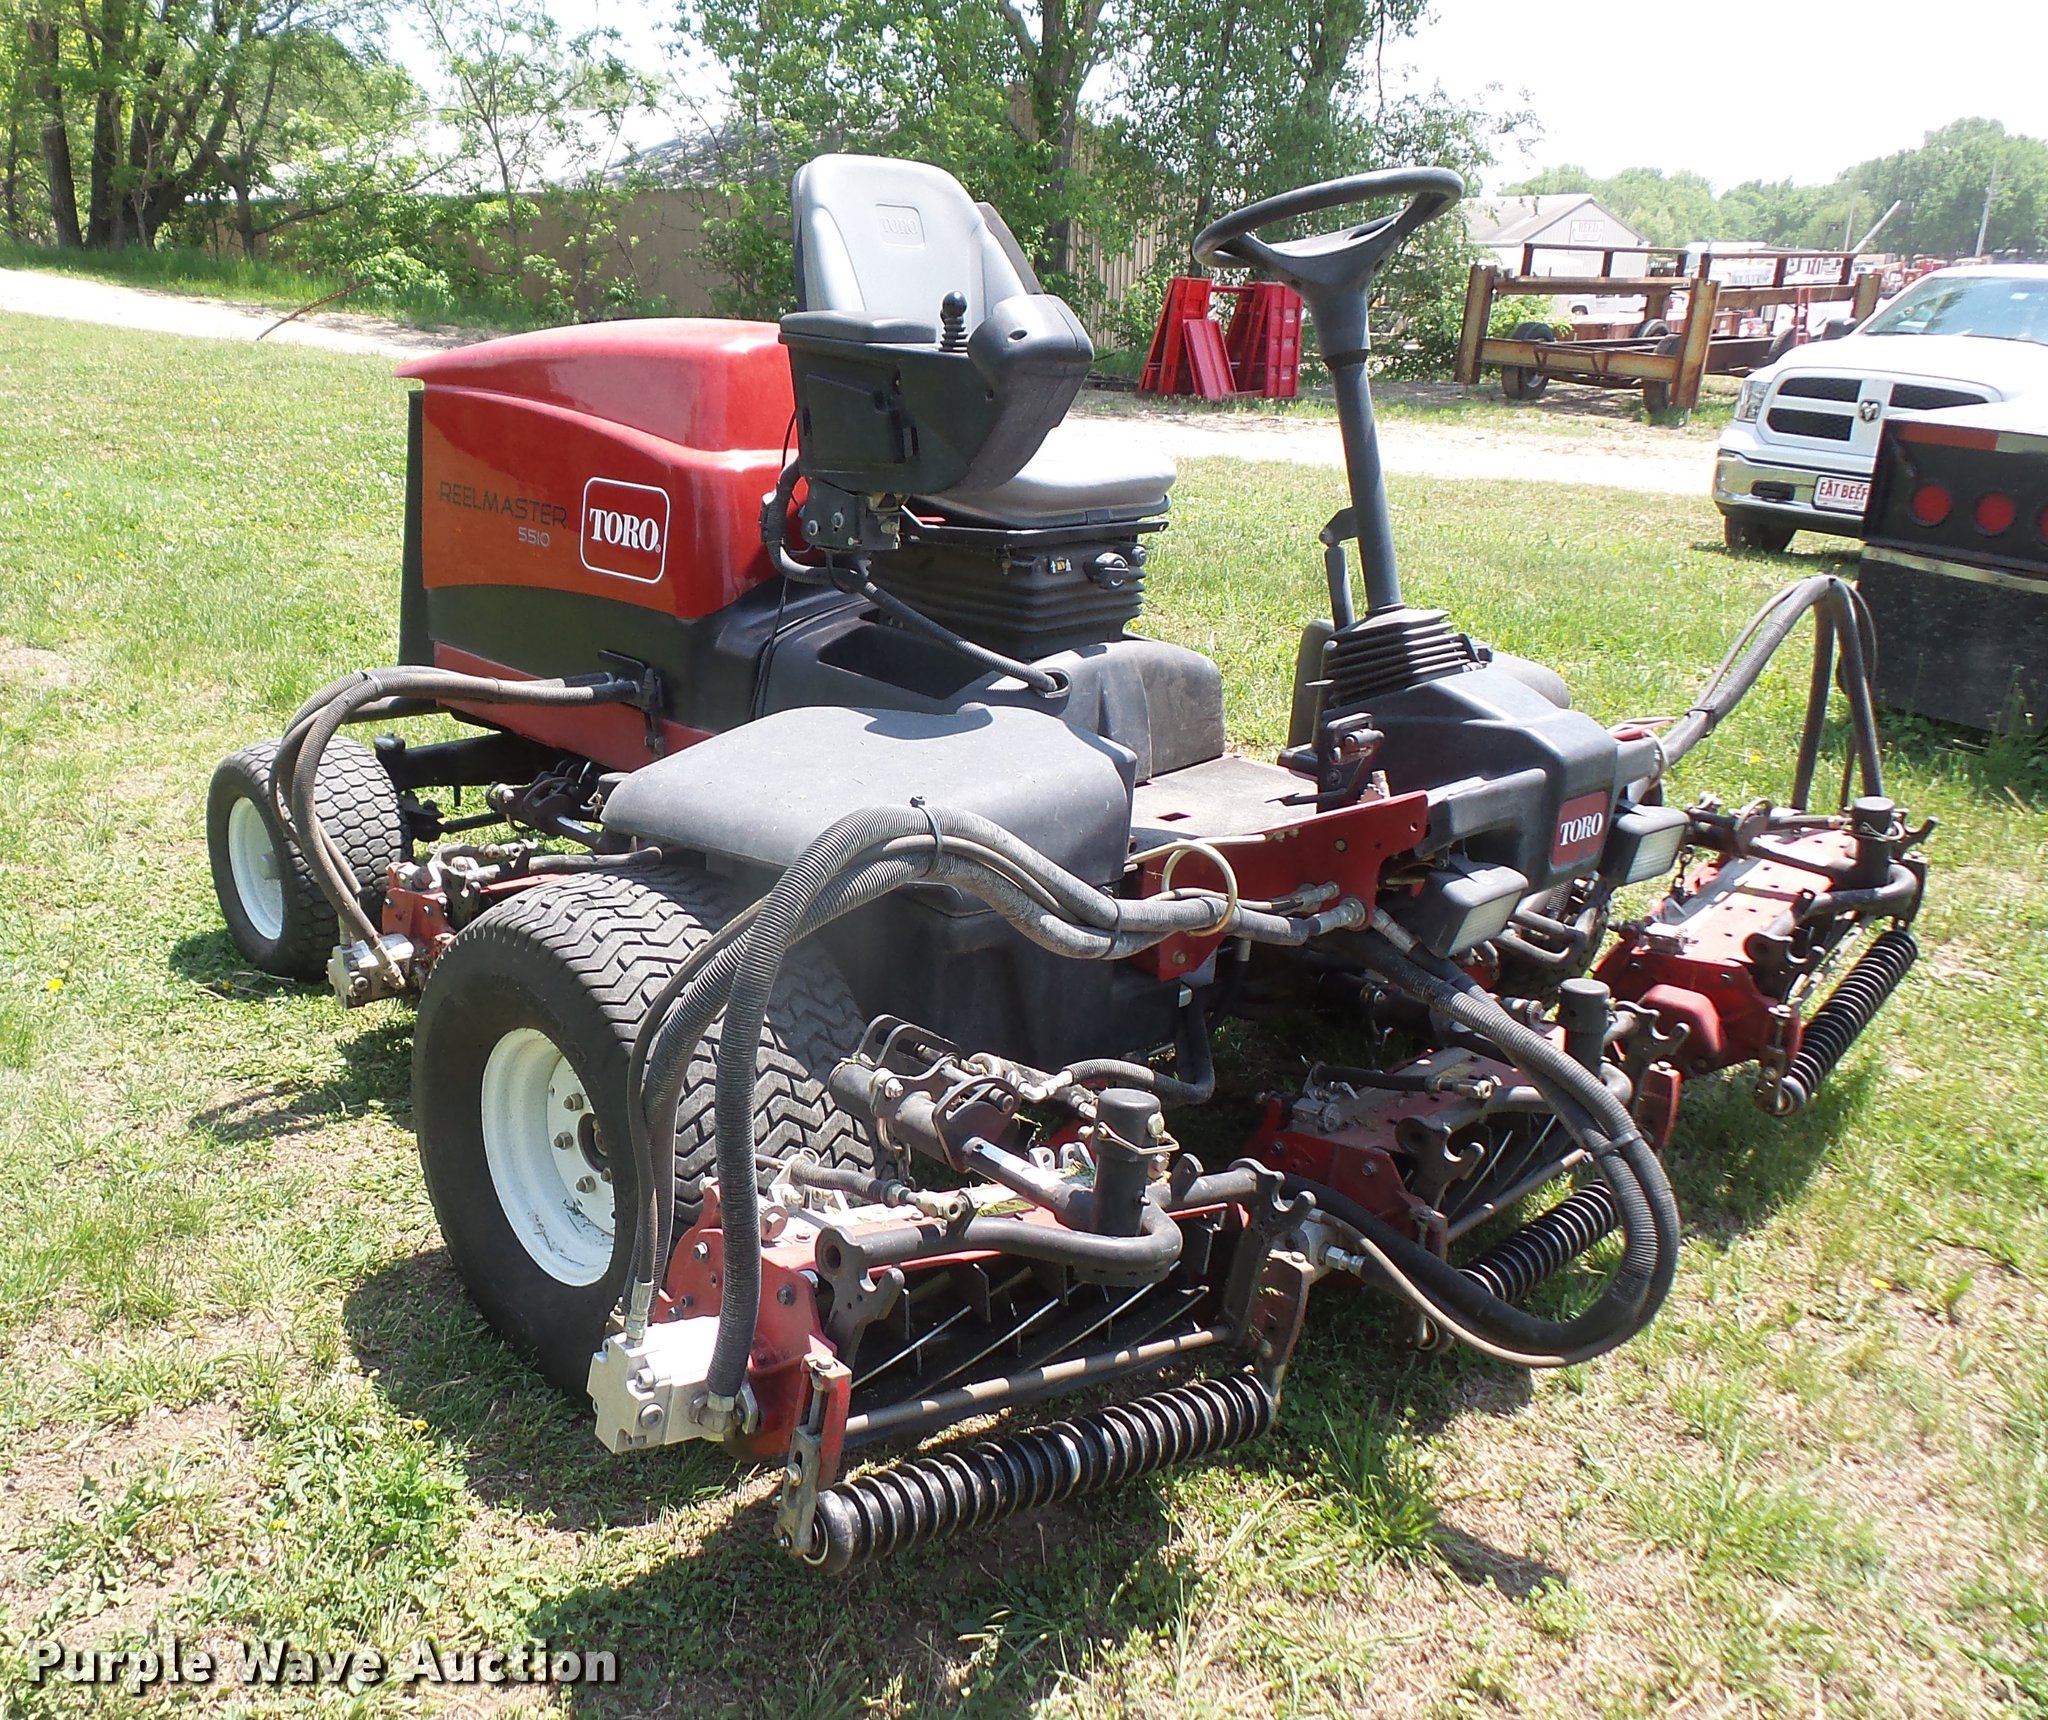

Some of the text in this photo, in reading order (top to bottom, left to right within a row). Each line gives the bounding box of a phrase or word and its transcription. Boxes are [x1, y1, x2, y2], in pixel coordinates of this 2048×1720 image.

[438, 480, 568, 529] REELMASTER
[1819, 481, 1867, 500] EAT BEEF
[518, 527, 551, 548] 5510
[589, 508, 659, 551] TORO
[1560, 812, 1603, 846] TORO
